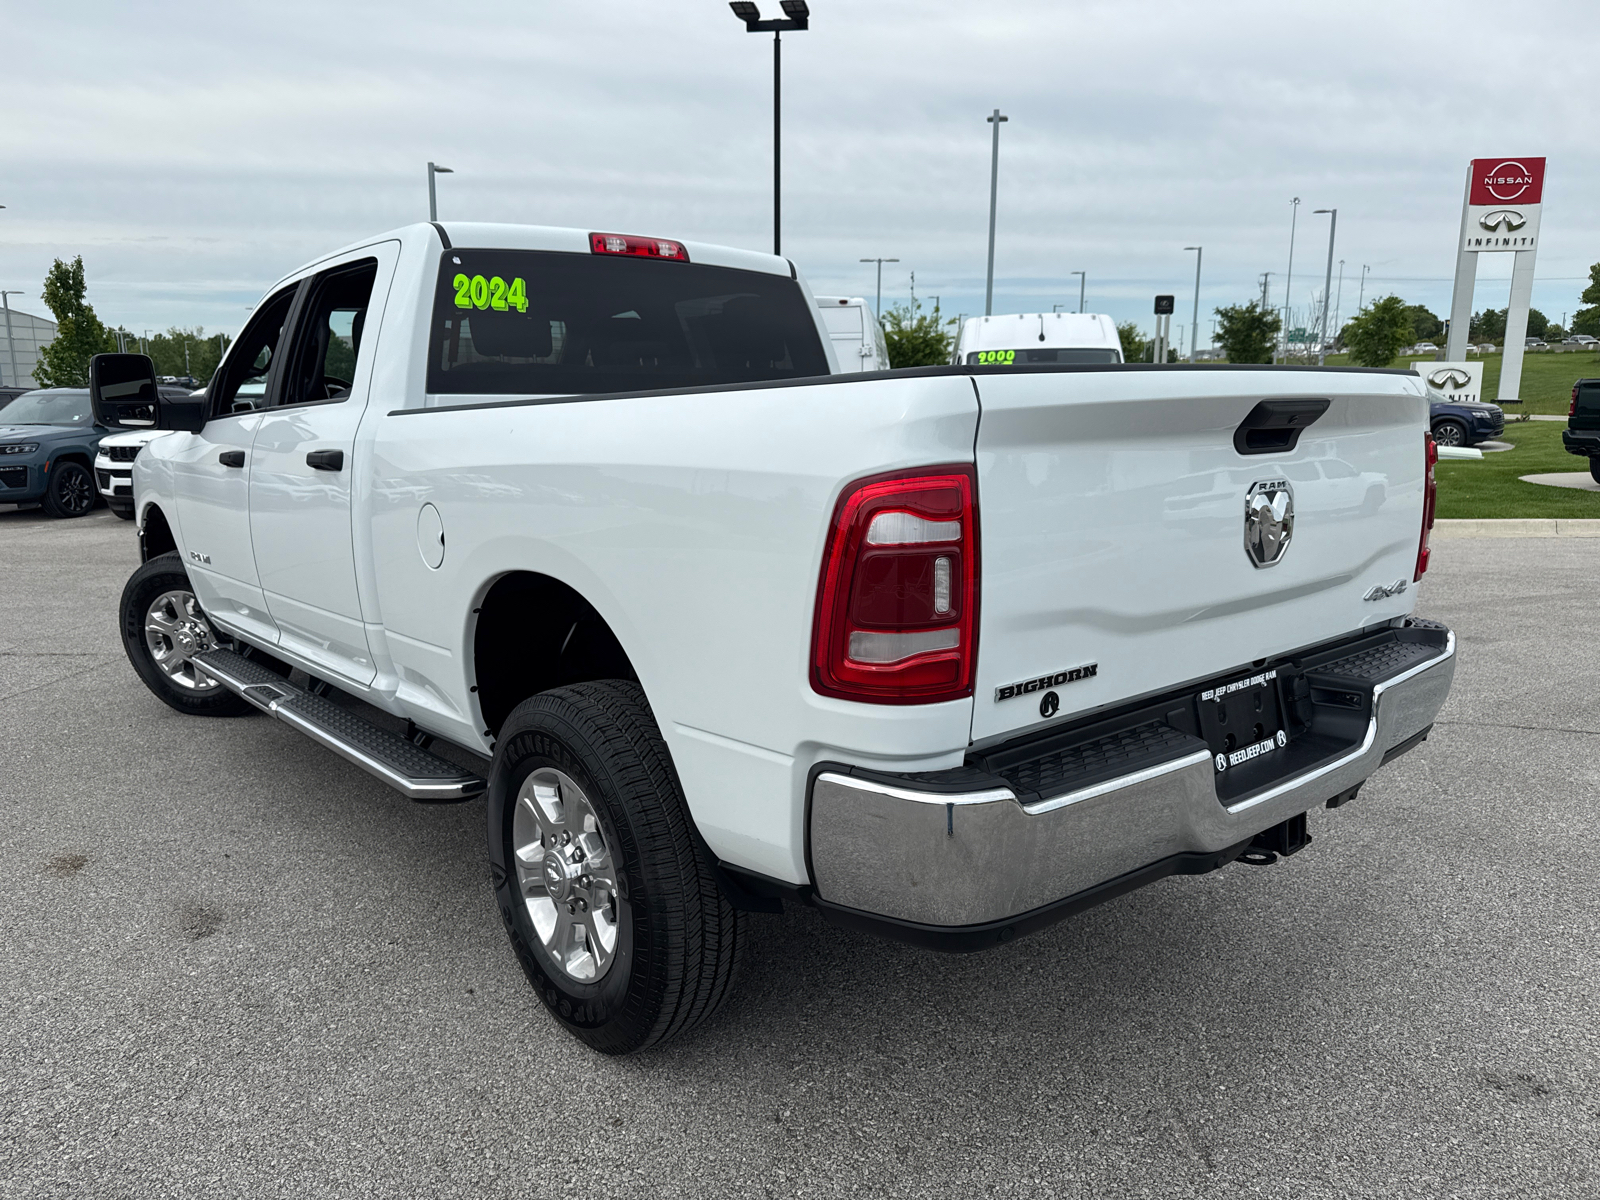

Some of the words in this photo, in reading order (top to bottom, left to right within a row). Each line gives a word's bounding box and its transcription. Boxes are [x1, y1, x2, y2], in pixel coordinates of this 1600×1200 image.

[1467, 237, 1534, 246] INFINITI
[453, 273, 529, 313] 2024
[978, 350, 1015, 362] 9000
[1258, 481, 1287, 490] RAM
[994, 662, 1098, 703] BIGHORN
[1201, 690, 1214, 701] REED
[1214, 686, 1226, 697] JEEP
[1227, 678, 1250, 693] CHRYSLER
[1250, 673, 1266, 685] DODGE
[1265, 670, 1277, 681] RAM
[1229, 738, 1275, 766] REEDJEEP.COM
